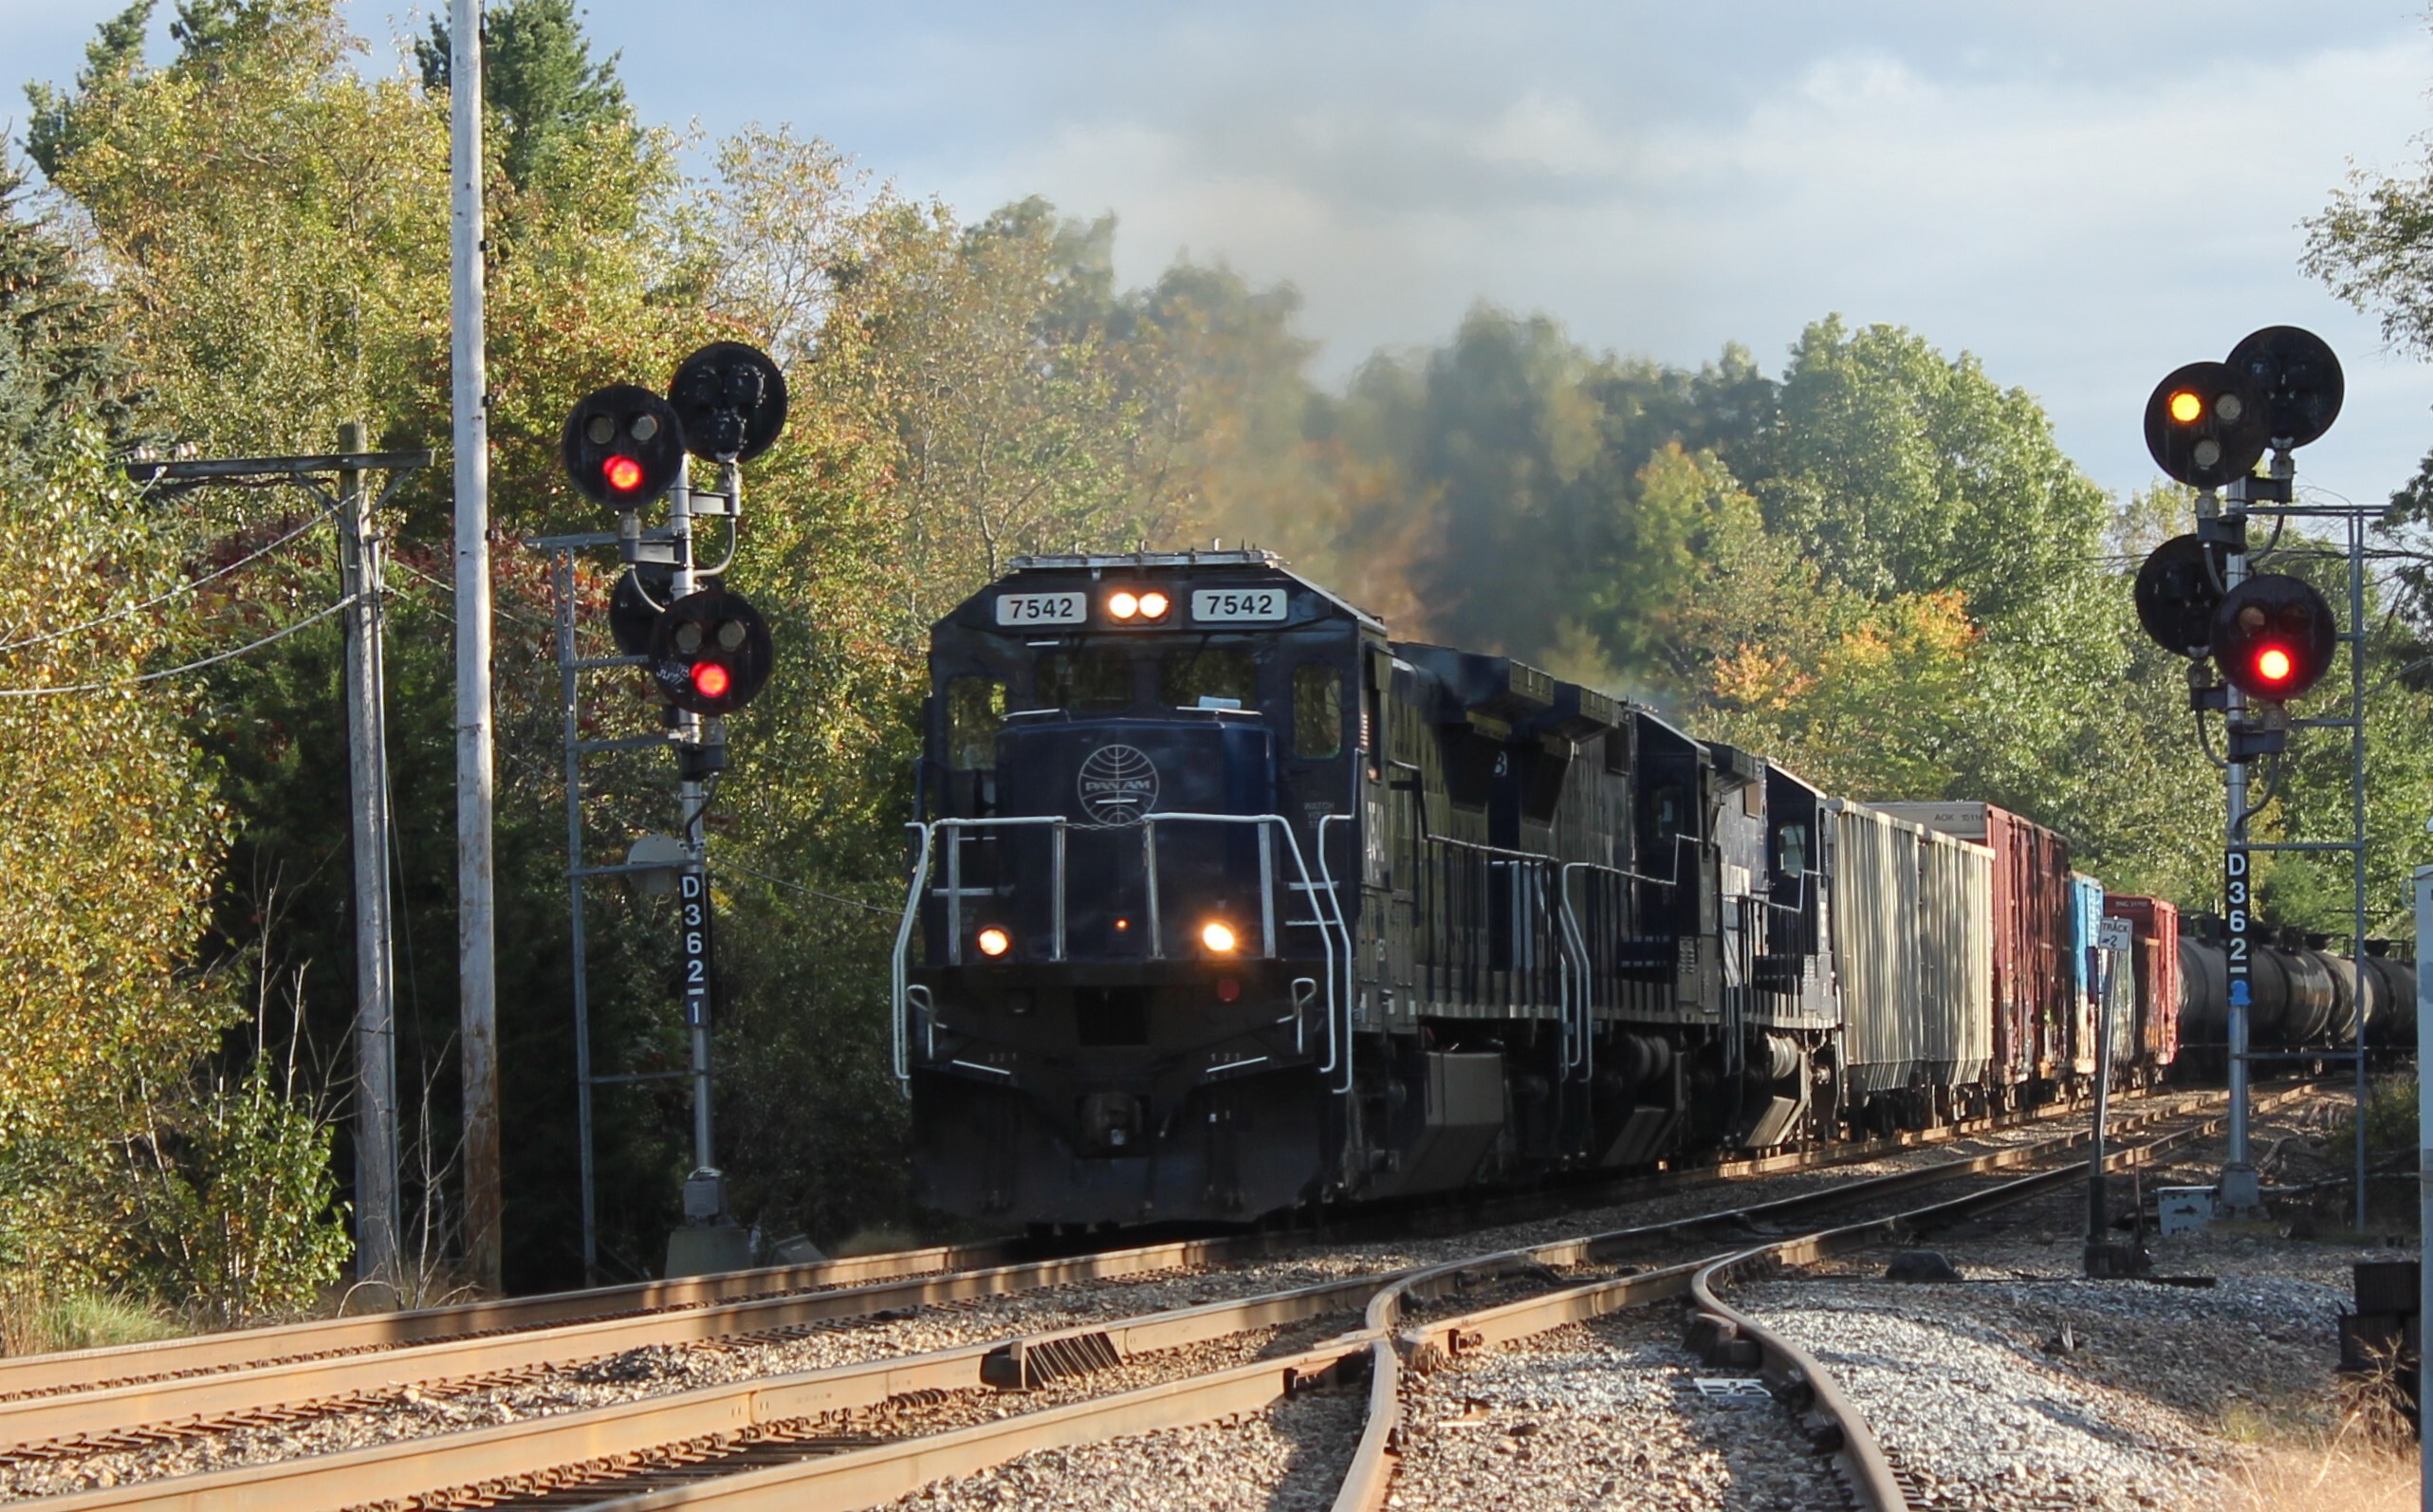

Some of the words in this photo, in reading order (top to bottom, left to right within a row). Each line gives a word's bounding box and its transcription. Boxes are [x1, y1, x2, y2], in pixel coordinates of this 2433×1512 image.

[1009, 598, 1073, 618] 7542
[1207, 595, 1273, 616] 7542
[1085, 781, 1119, 791] PAN
[1122, 780, 1151, 789] AM
[2101, 922, 2129, 933] TRACK
